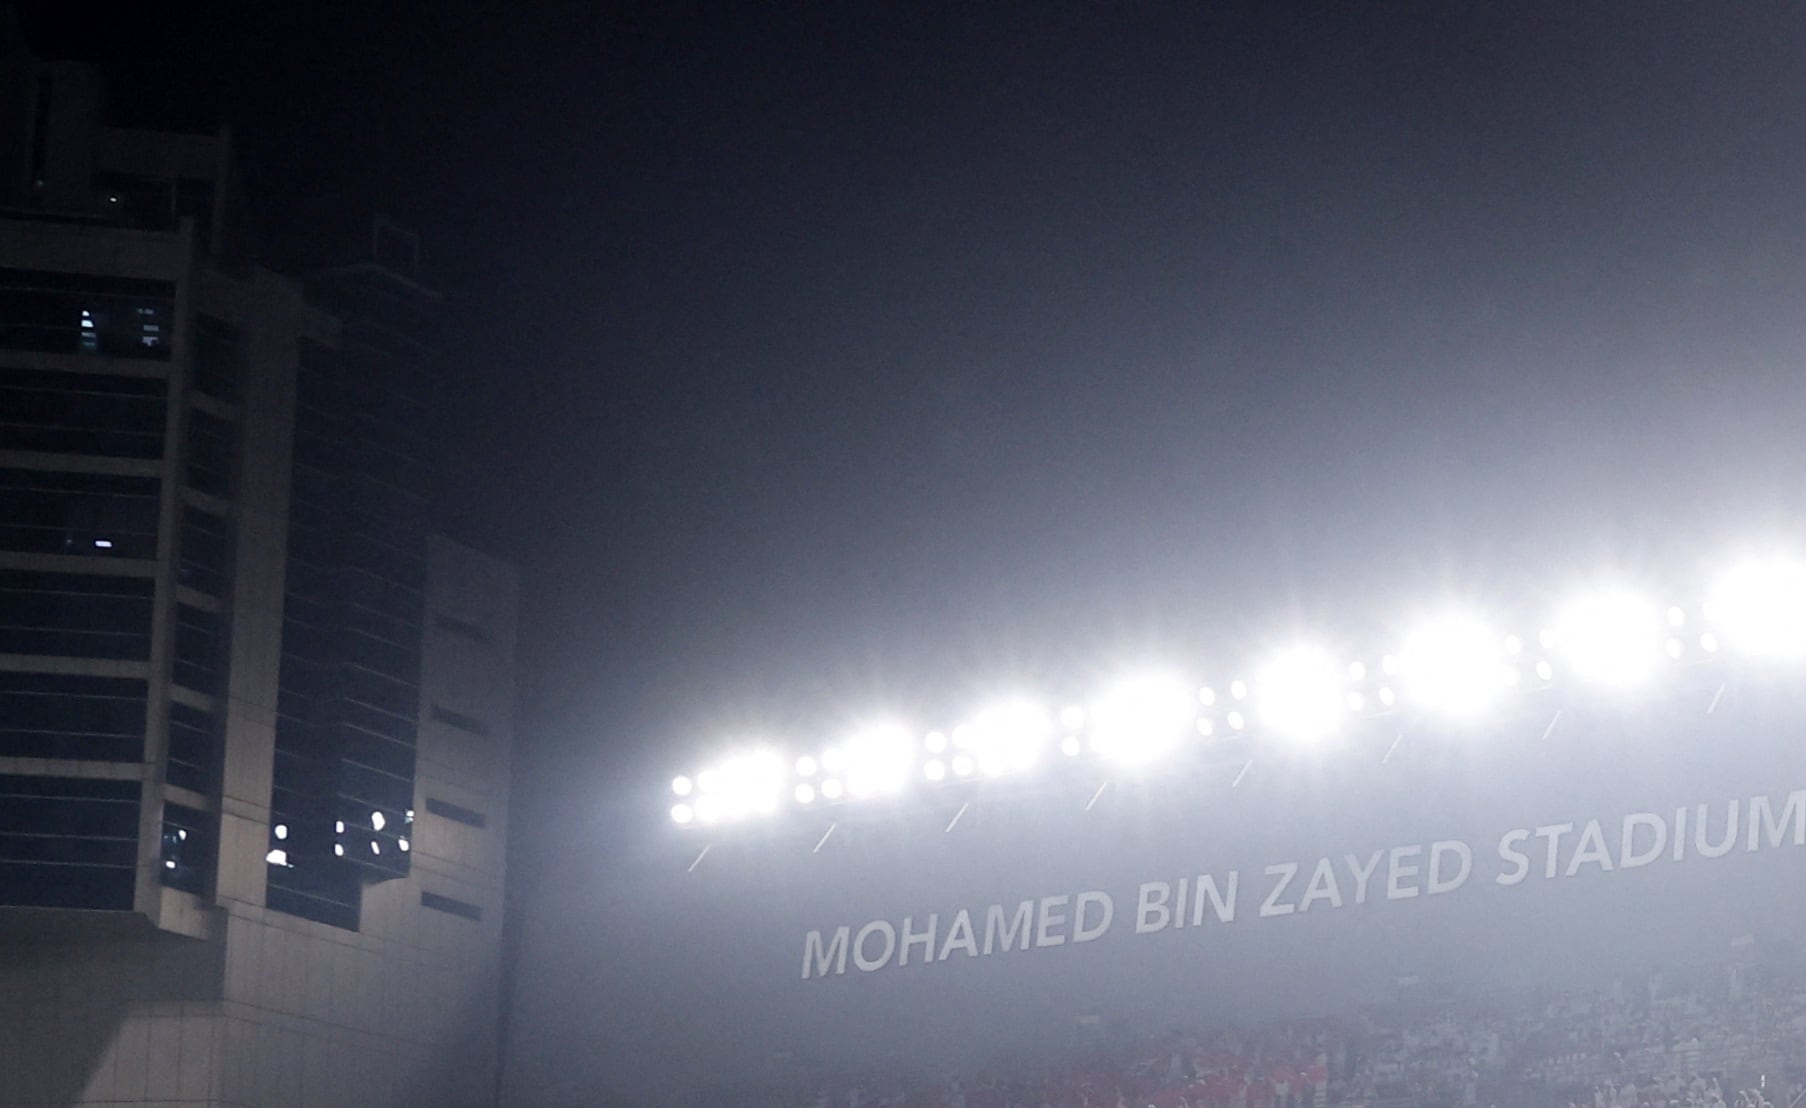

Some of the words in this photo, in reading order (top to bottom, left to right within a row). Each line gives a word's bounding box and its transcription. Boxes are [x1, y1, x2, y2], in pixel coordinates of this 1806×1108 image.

[801, 890, 1115, 979] MOHAMED
[1135, 870, 1239, 934] BIN
[1259, 838, 1473, 918] ZAYED
